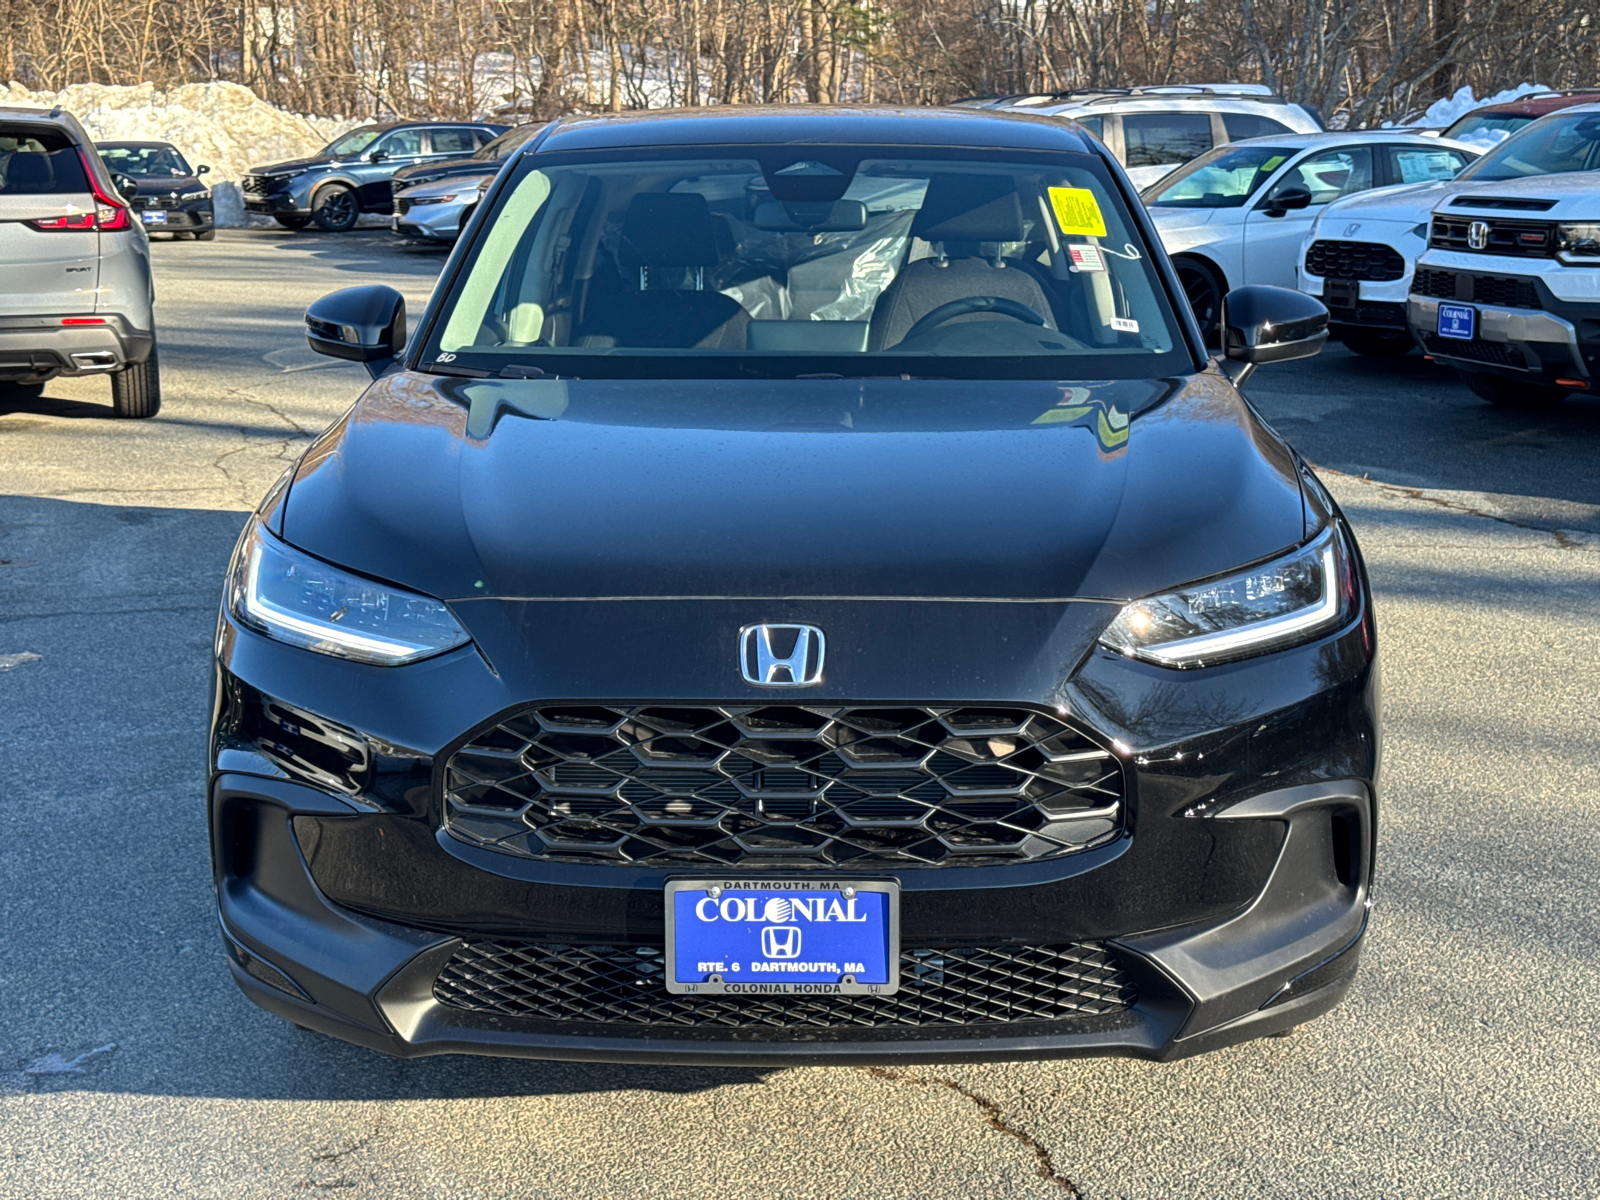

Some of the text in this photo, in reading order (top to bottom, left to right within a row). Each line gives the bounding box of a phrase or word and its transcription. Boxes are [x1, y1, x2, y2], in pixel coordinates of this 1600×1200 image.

[723, 881, 841, 890] DARTMOUTH, MA
[695, 897, 867, 924] COLONIAL
[697, 962, 866, 974] RTE. 6 DARTMOUTH, MA
[723, 984, 842, 994] COLONIAL HONDA
